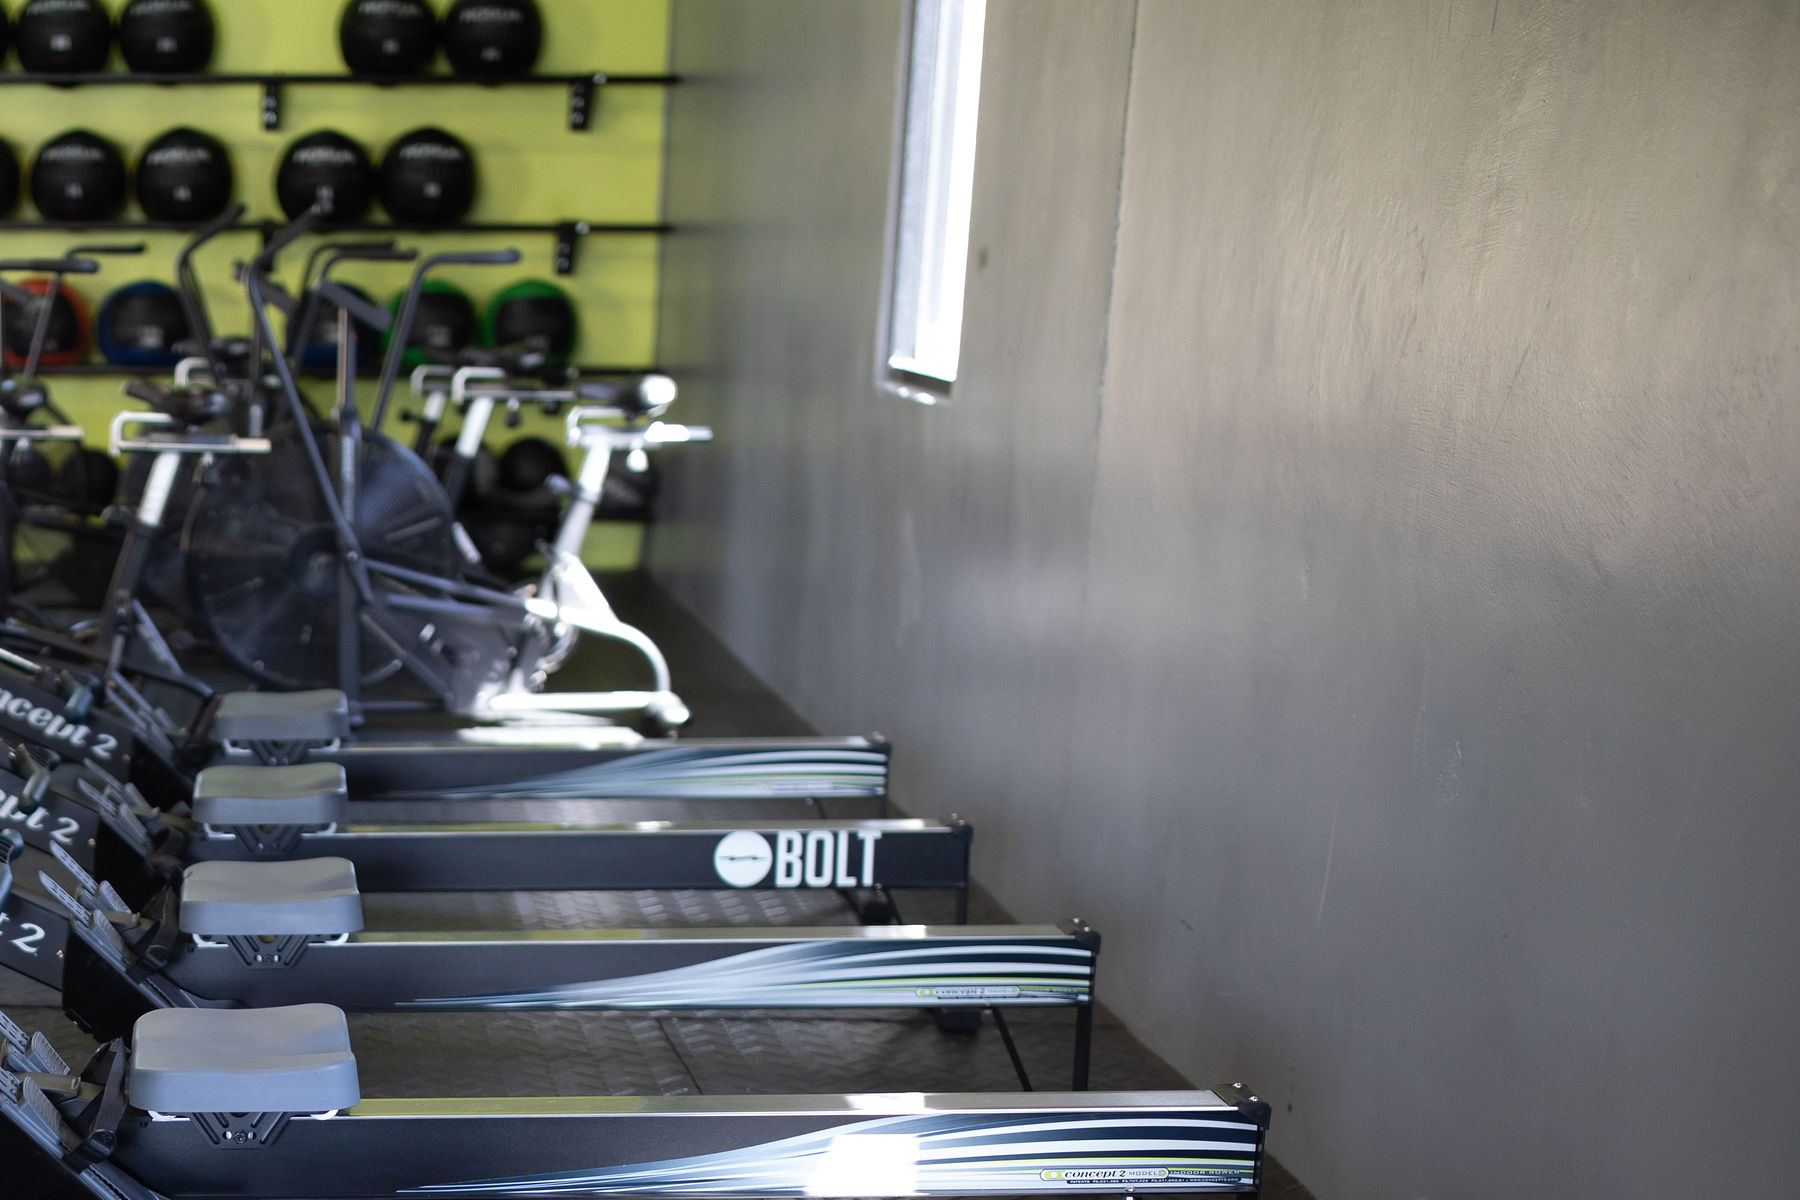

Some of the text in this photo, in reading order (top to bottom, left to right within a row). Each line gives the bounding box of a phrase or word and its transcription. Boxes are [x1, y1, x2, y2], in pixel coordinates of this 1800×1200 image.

[91, 733, 118, 760] 2
[50, 816, 80, 845] 2
[775, 830, 882, 888] BOLT
[11, 922, 47, 954] 2
[1064, 1170, 1118, 1179] concept
[1119, 1169, 1127, 1177] 2
